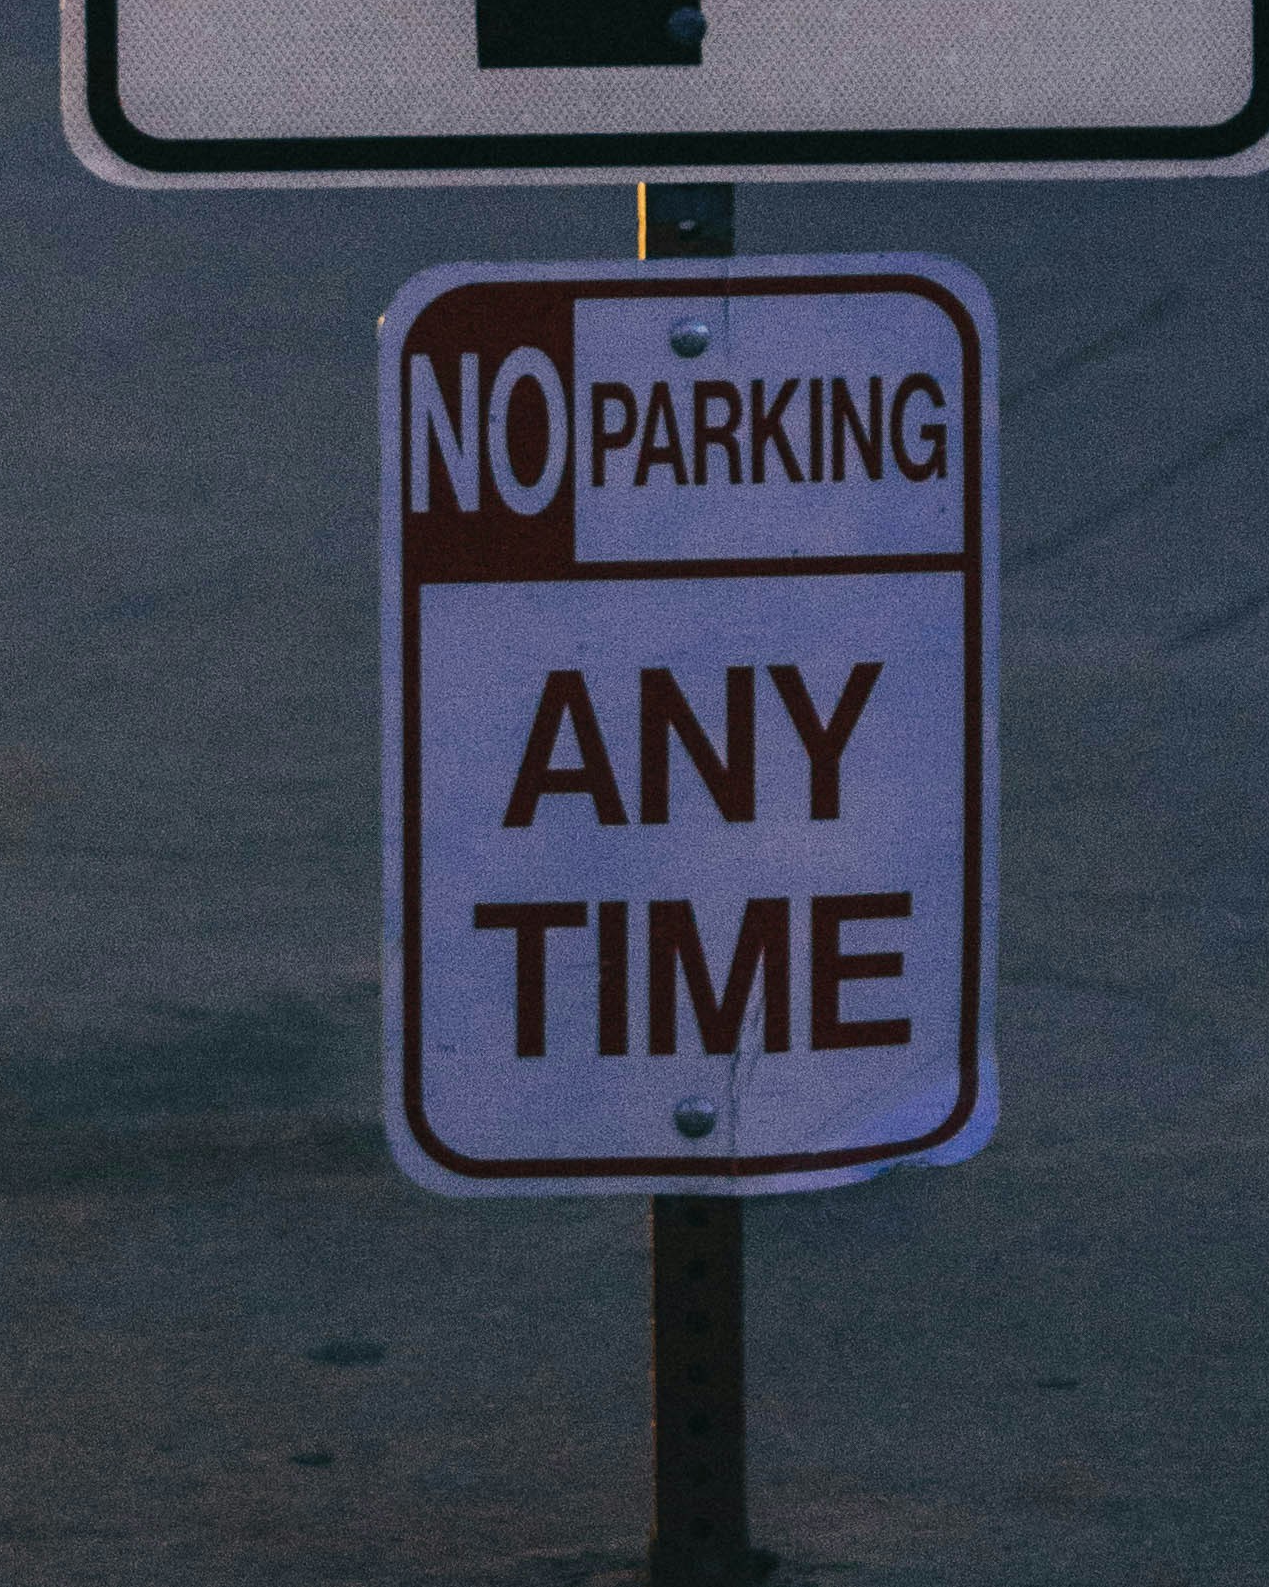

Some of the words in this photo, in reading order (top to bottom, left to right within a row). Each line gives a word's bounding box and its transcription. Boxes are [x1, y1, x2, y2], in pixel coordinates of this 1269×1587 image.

[411, 346, 568, 516] NO
[590, 372, 948, 488] PARKING
[503, 662, 885, 827] ANY
[474, 892, 912, 1058] TIME
